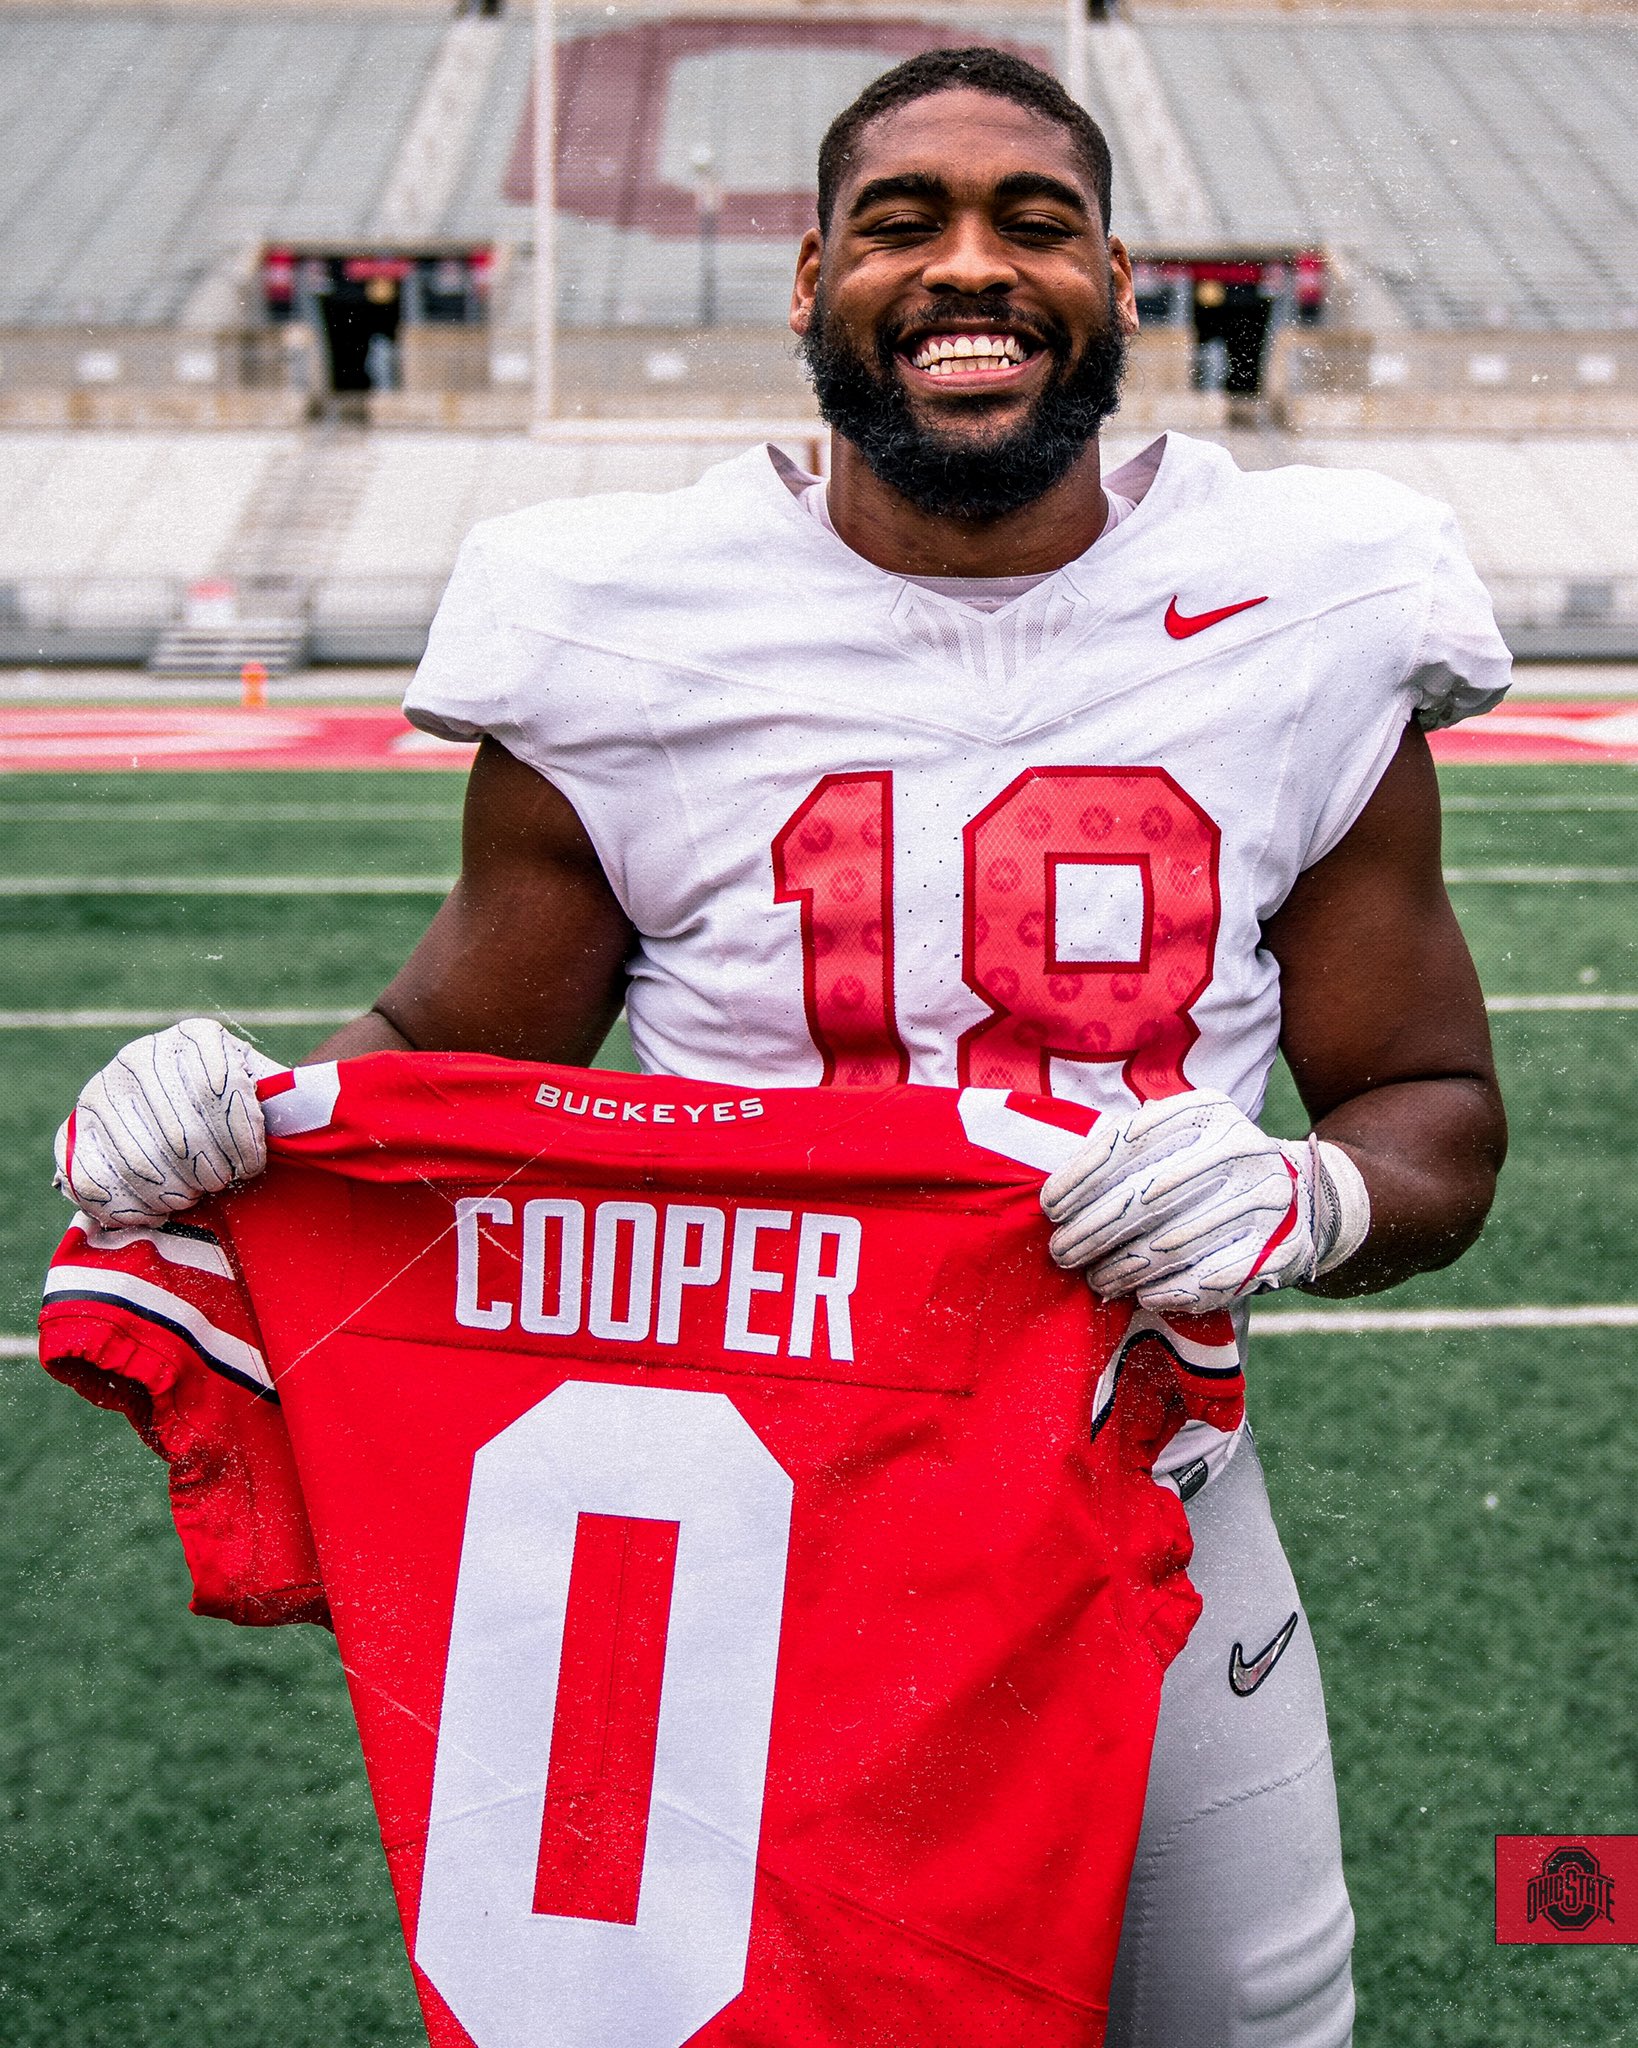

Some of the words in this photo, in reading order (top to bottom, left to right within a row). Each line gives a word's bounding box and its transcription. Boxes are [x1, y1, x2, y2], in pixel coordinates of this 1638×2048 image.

[771, 765, 1222, 1106] 18
[534, 1082, 765, 1124] BUCKEYES
[454, 1196, 863, 1363] COOPER
[1190, 1460, 1205, 1476] PRO
